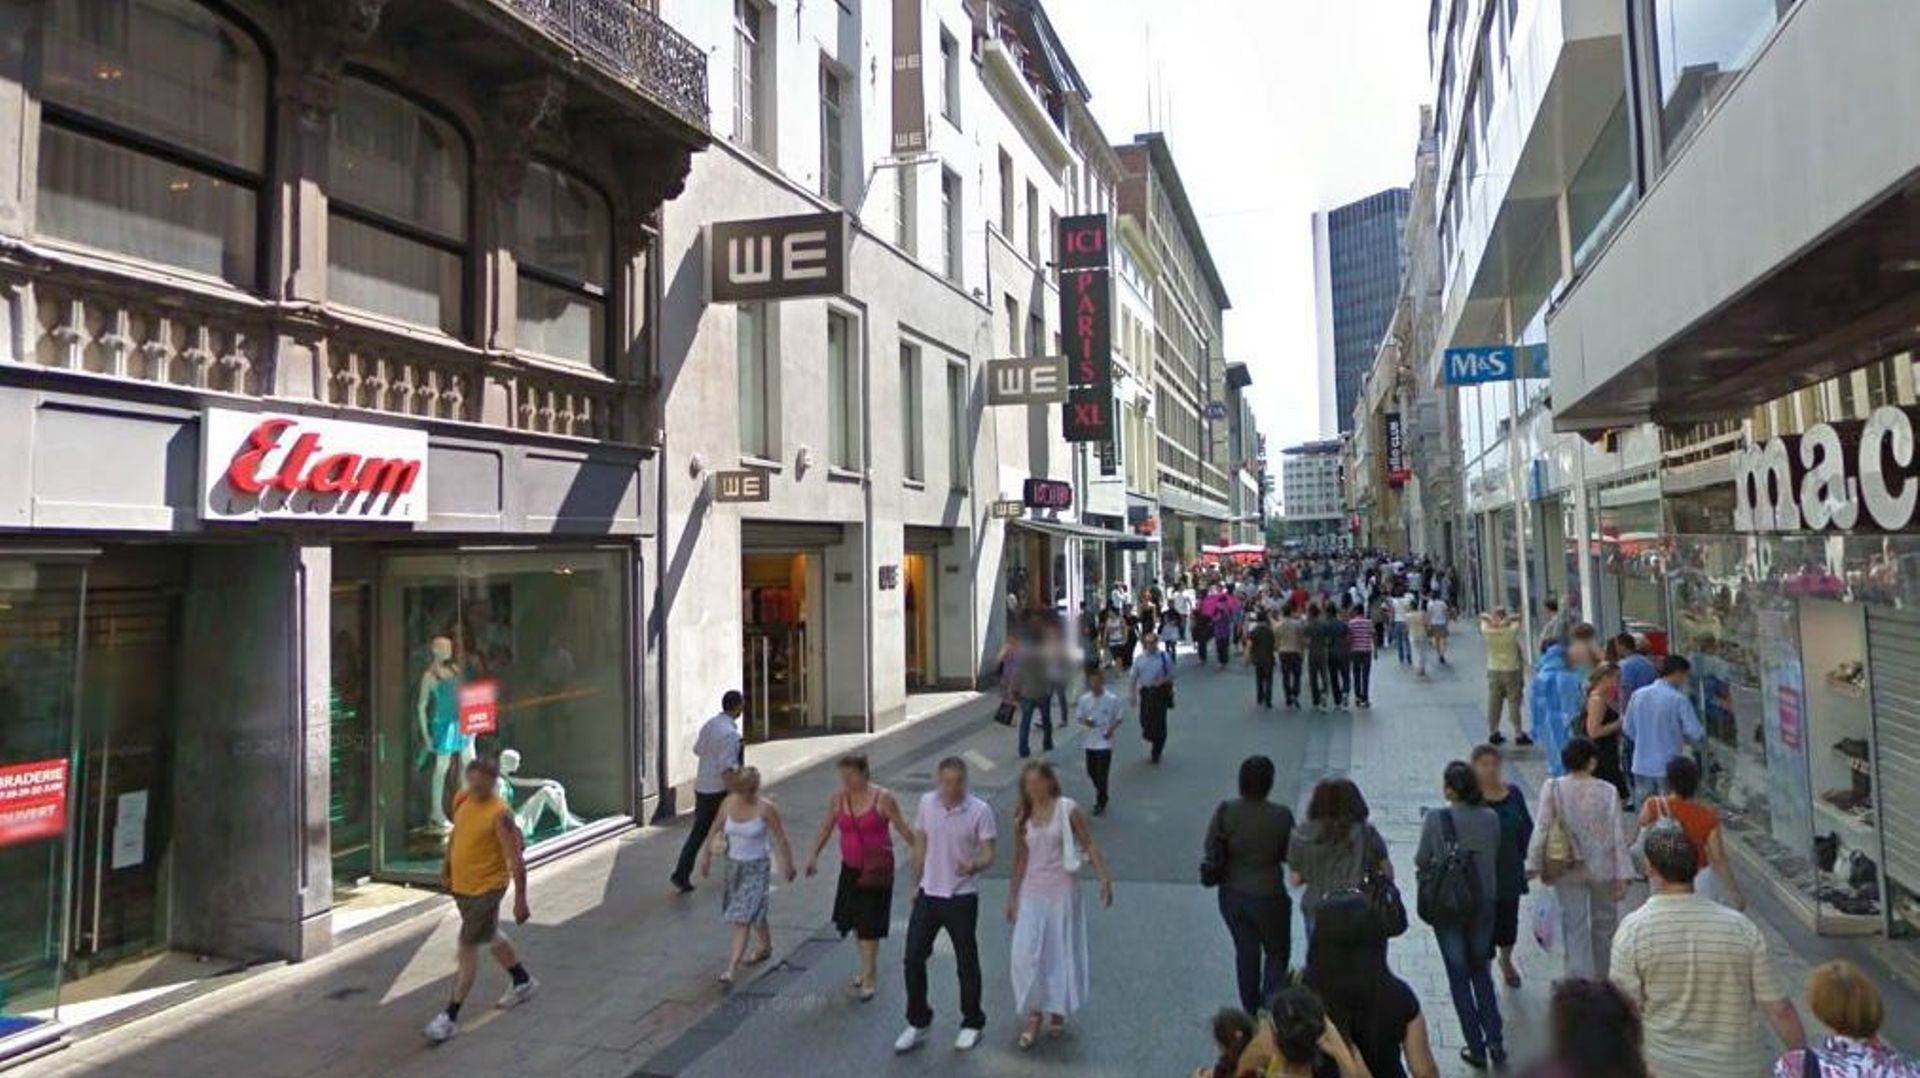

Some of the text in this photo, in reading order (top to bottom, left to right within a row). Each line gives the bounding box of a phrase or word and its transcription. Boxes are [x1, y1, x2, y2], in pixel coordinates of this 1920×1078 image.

[894, 54, 920, 71] WE
[895, 132, 921, 147] WE
[1066, 229, 1104, 252] ICI
[728, 229, 827, 283] WE
[1076, 273, 1096, 384] PARIS
[1451, 350, 1507, 378] M&S
[998, 366, 1057, 395] WE
[1075, 402, 1103, 424] XL
[228, 418, 421, 493] Etam
[1729, 405, 1919, 532] mac
[723, 477, 760, 496] WE
[996, 503, 1020, 516] WE
